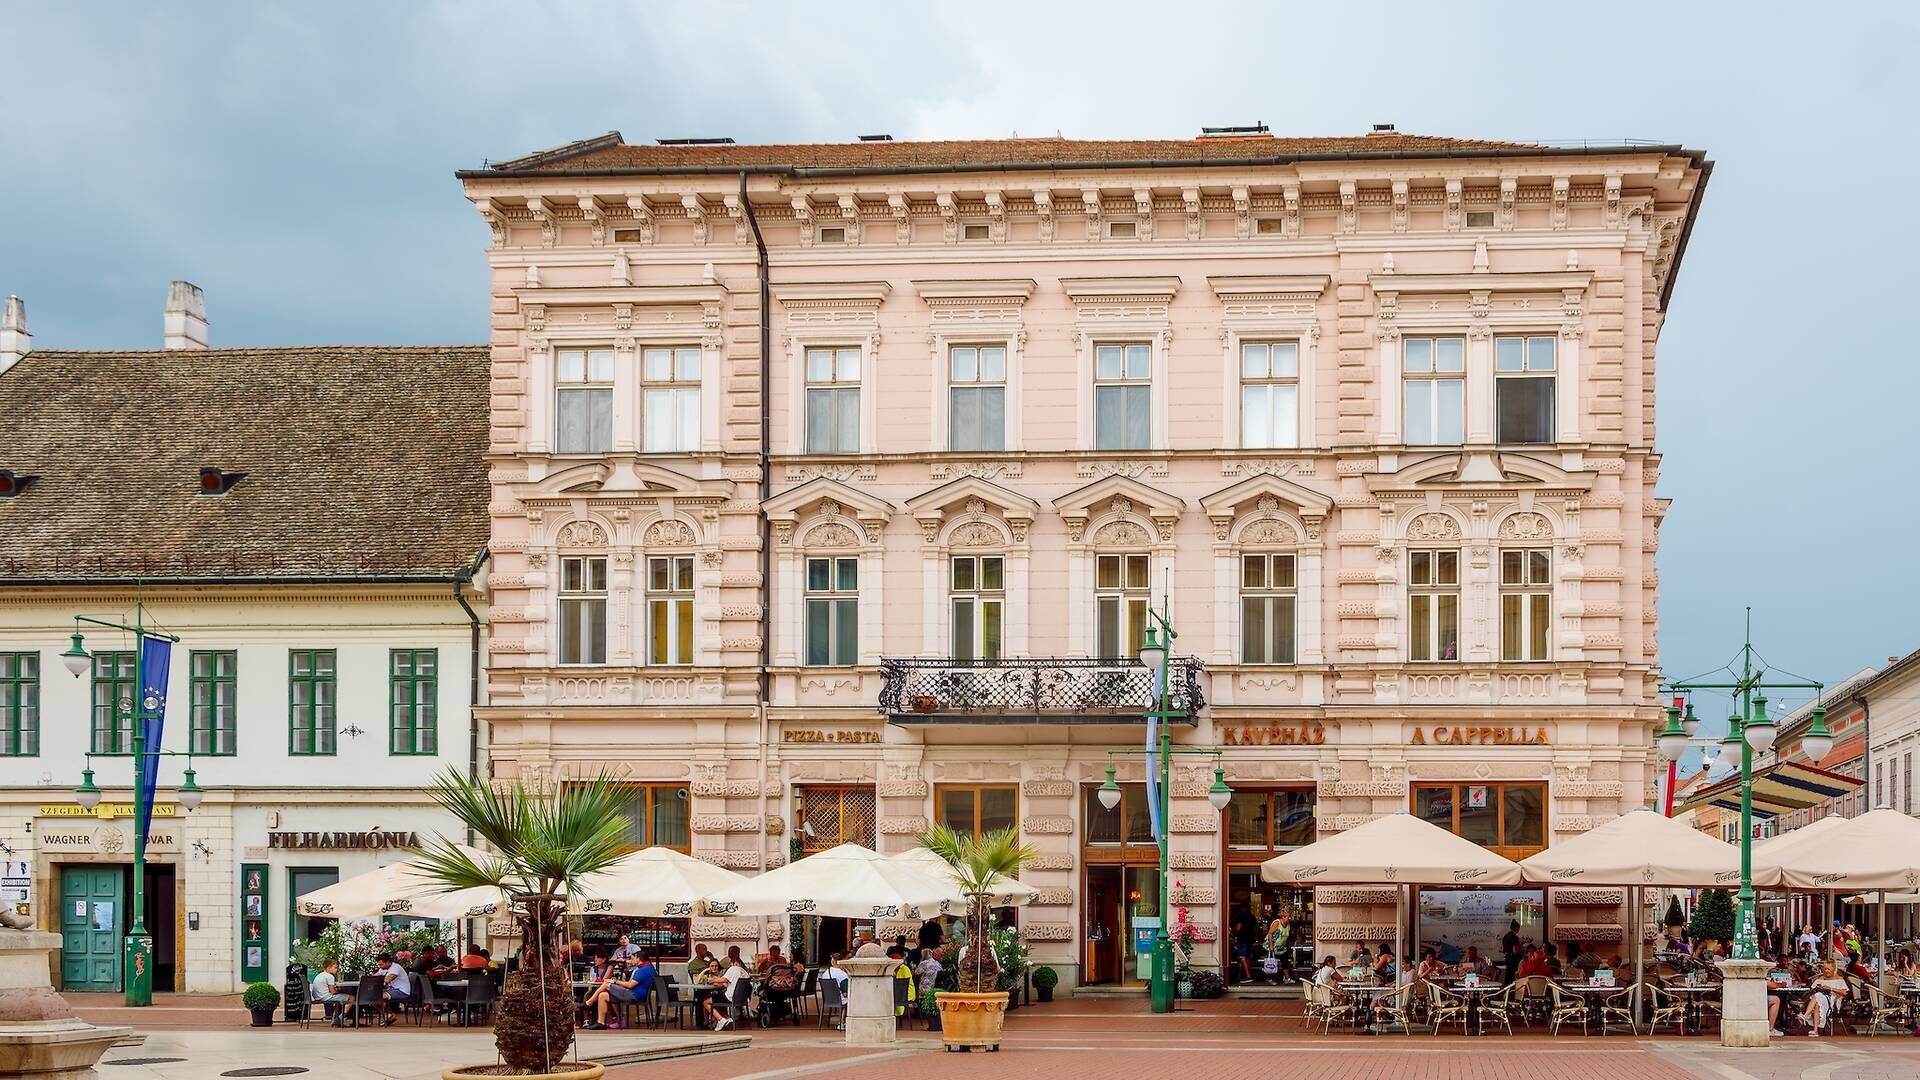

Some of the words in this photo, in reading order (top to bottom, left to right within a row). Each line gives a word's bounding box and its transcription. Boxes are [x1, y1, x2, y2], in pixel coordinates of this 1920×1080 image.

[783, 730, 825, 743] PIZZA
[836, 731, 881, 743] PASTA
[1223, 720, 1325, 744] KÁVÉHÁZ
[1411, 727, 1425, 745] A
[1433, 727, 1549, 745] CAPPELLA
[43, 834, 91, 845] WAGNER
[267, 825, 422, 849] FILHARMÓNIA
